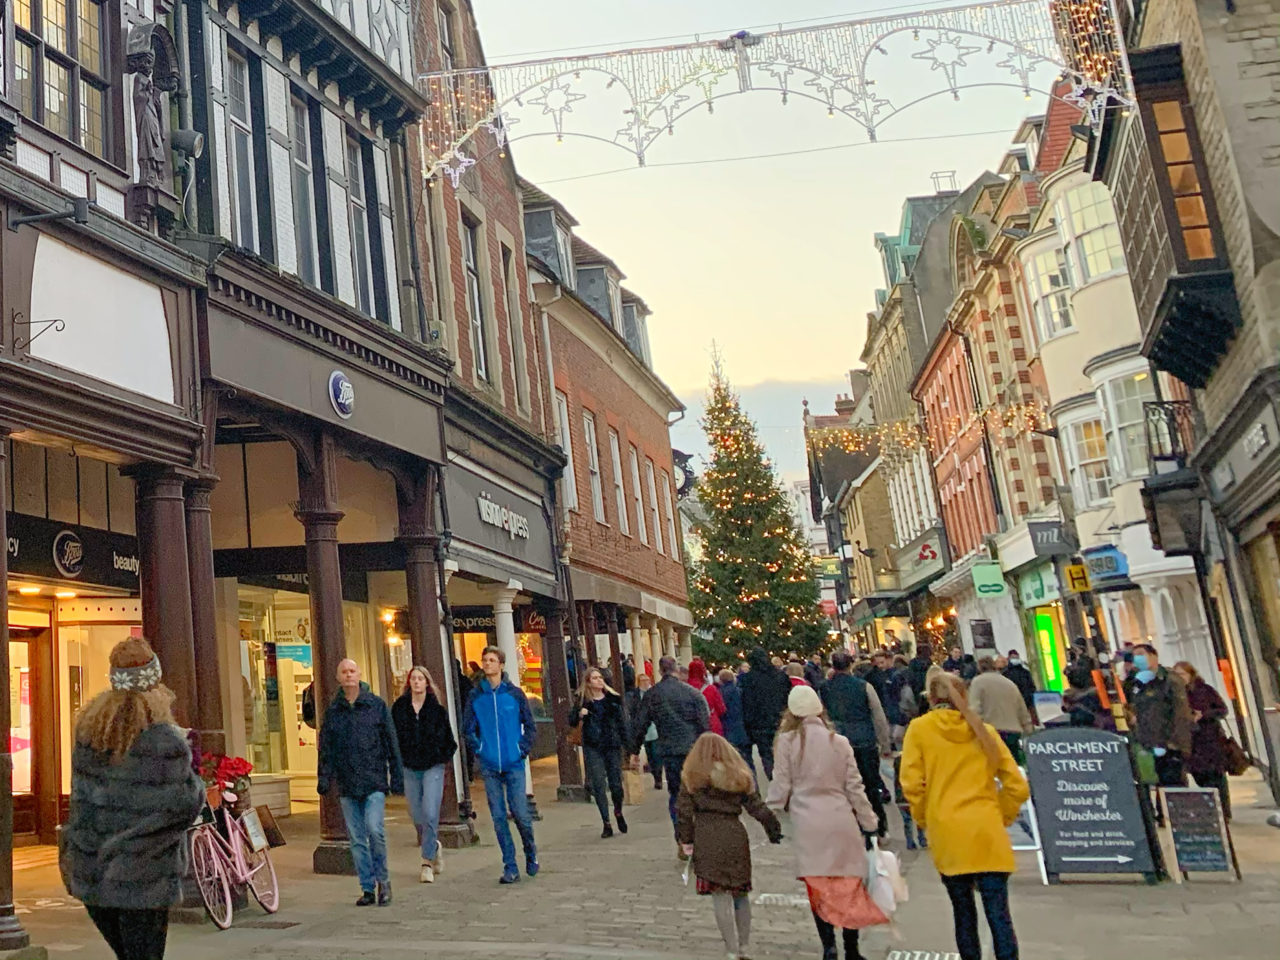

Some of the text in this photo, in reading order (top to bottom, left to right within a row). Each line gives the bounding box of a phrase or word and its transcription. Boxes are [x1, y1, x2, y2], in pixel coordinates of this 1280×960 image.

[113, 551, 140, 576] beauty
[1069, 567, 1089, 589] H
[1028, 741, 1120, 755] PARCHMENT
[1051, 759, 1105, 772] STREET
[1056, 780, 1110, 791] Discover
[1064, 794, 1108, 809] more of
[1055, 809, 1123, 821] Winchester
